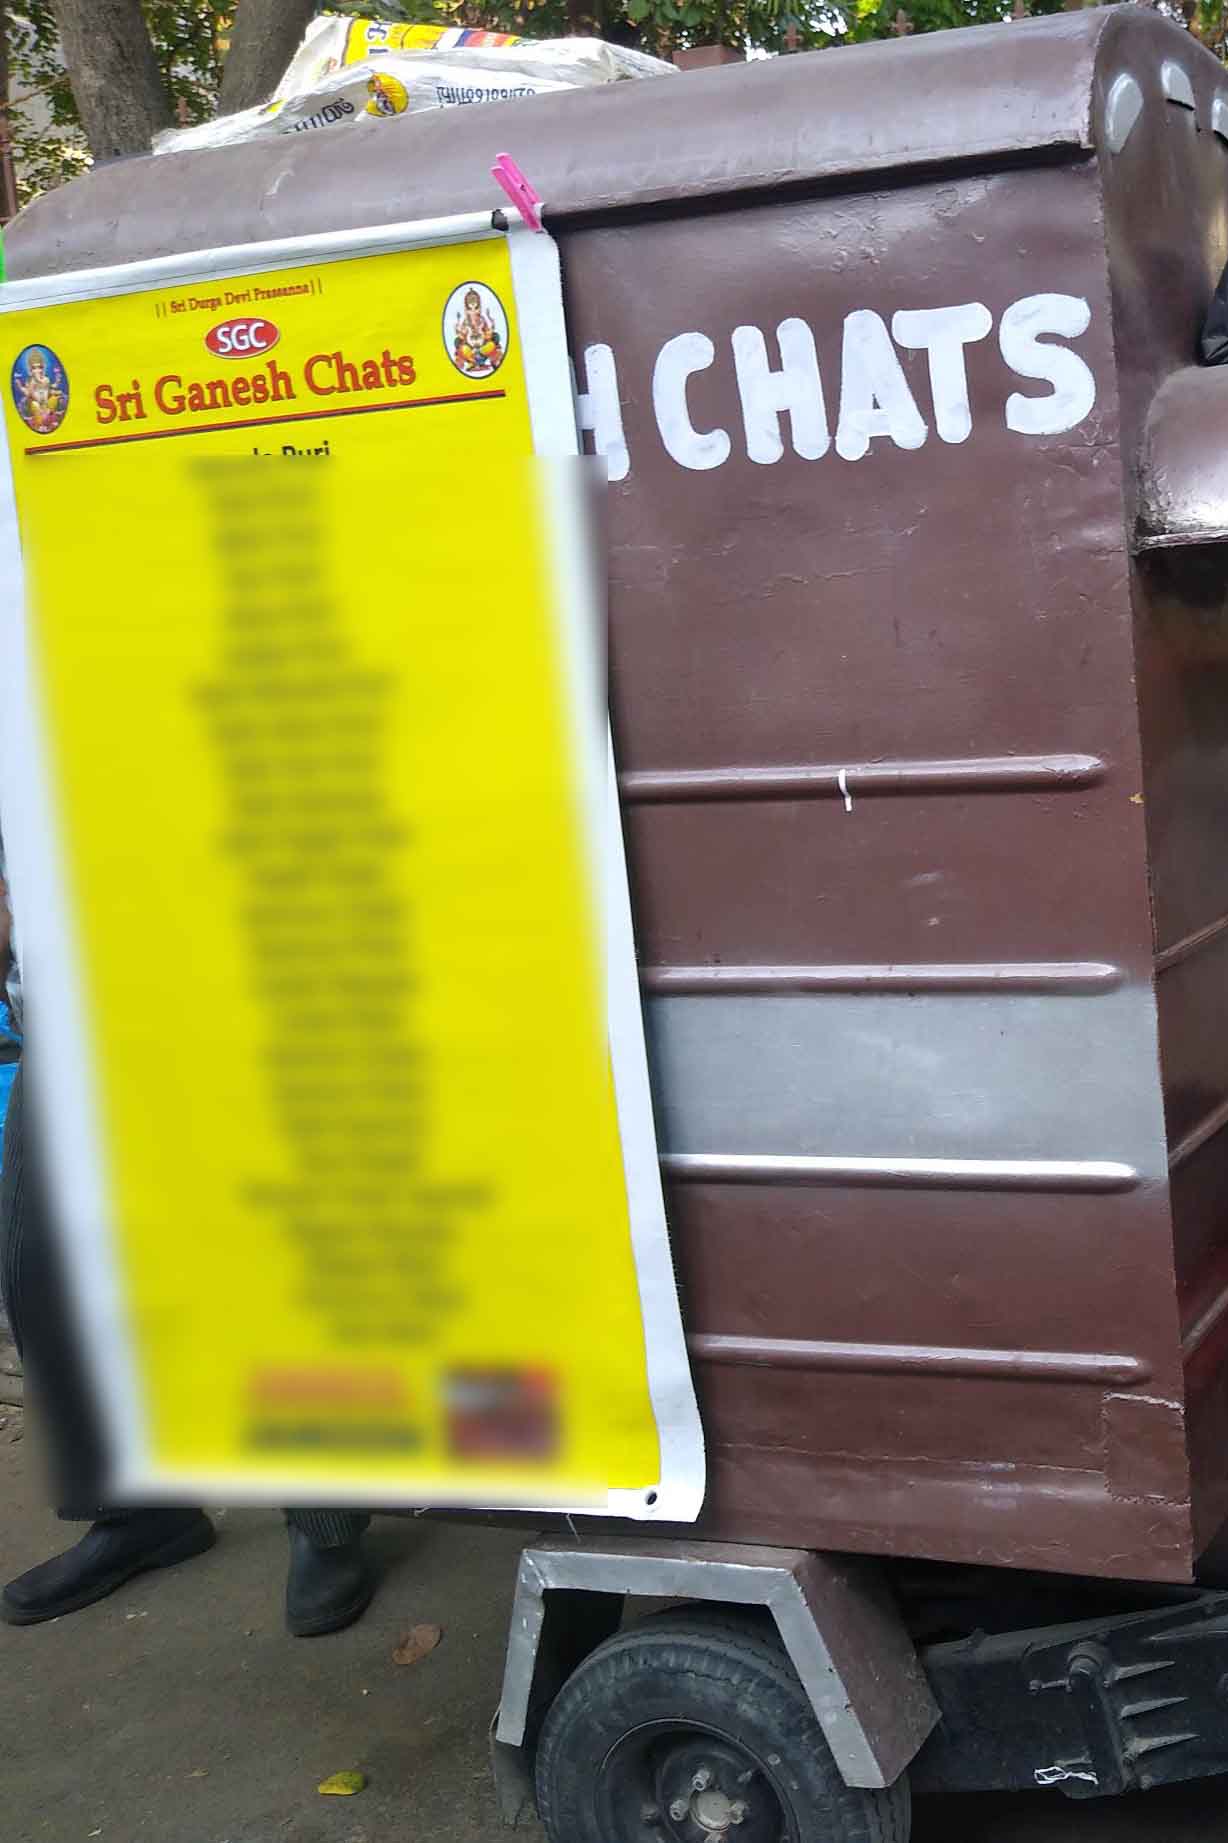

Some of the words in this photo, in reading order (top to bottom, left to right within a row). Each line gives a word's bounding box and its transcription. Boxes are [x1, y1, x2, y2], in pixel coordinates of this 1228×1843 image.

[215, 321, 268, 354] SGC
[94, 379, 147, 425] Sri
[154, 358, 297, 416] Ganesh
[303, 348, 417, 397] Chats
[652, 292, 1096, 470] CHATS
